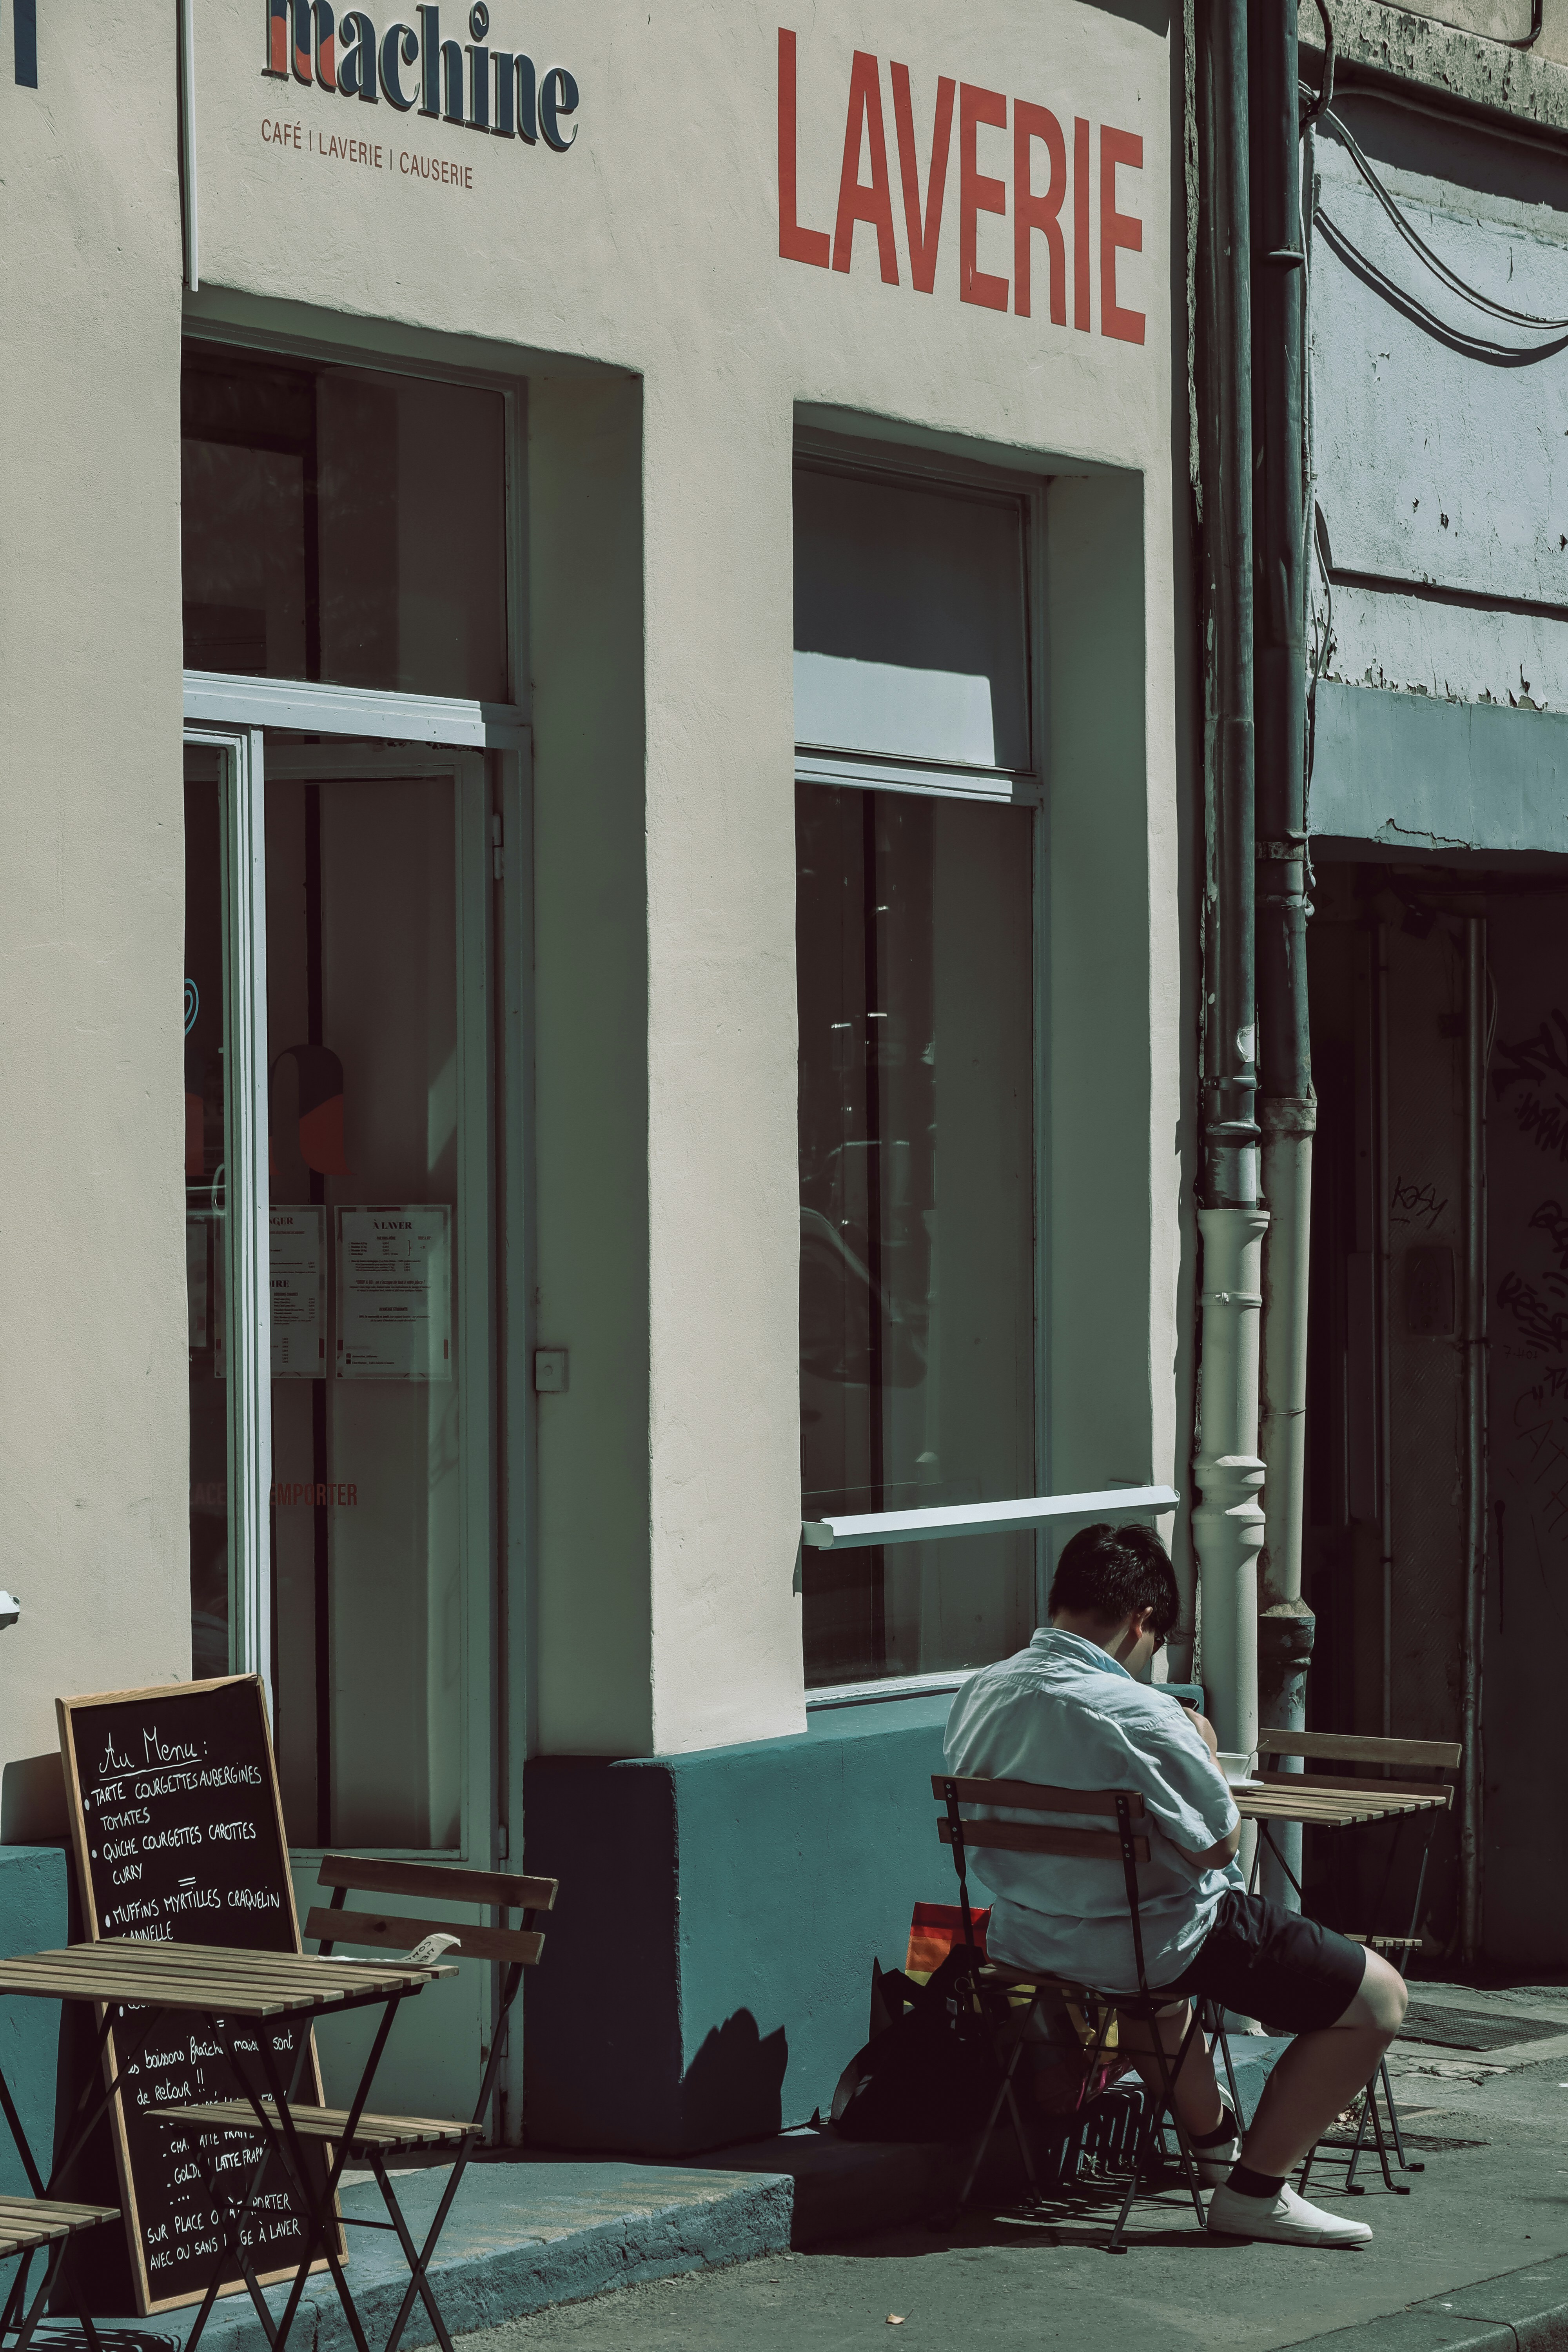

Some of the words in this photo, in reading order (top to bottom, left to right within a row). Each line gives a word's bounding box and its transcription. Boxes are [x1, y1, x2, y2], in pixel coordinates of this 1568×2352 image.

[261, 0, 580, 152] machine
[261, 119, 302, 150] CAFÉ
[318, 132, 383, 169] LAVERIE
[399, 152, 474, 189] CAUSERIE
[778, 27, 1146, 346] LAVERIE
[381, 1221, 412, 1229] LAVER
[99, 1732, 134, 1773] Au
[143, 1726, 197, 1763] Menu
[91, 1782, 126, 1806] TARTE
[135, 1773, 198, 1799] COURGETTES
[100, 1807, 151, 1831] TOMATES
[143, 1826, 201, 1850] COURGETTES
[209, 1822, 256, 1840] CAROTTES
[113, 1863, 142, 1885] CURRY
[122, 1921, 173, 1942] ANNELLE
[145, 2049, 185, 2069] boissons
[273, 2029, 294, 2051] sont
[137, 2088, 151, 2105] de
[215, 2152, 242, 2172] LATTE
[147, 2224, 169, 2244] SUR
[175, 2213, 205, 2234] PLACE
[151, 2251, 173, 2270] AVEC
[177, 2244, 190, 2260] OU
[195, 2237, 218, 2255] SANS
[270, 2218, 301, 2239] LAVER
